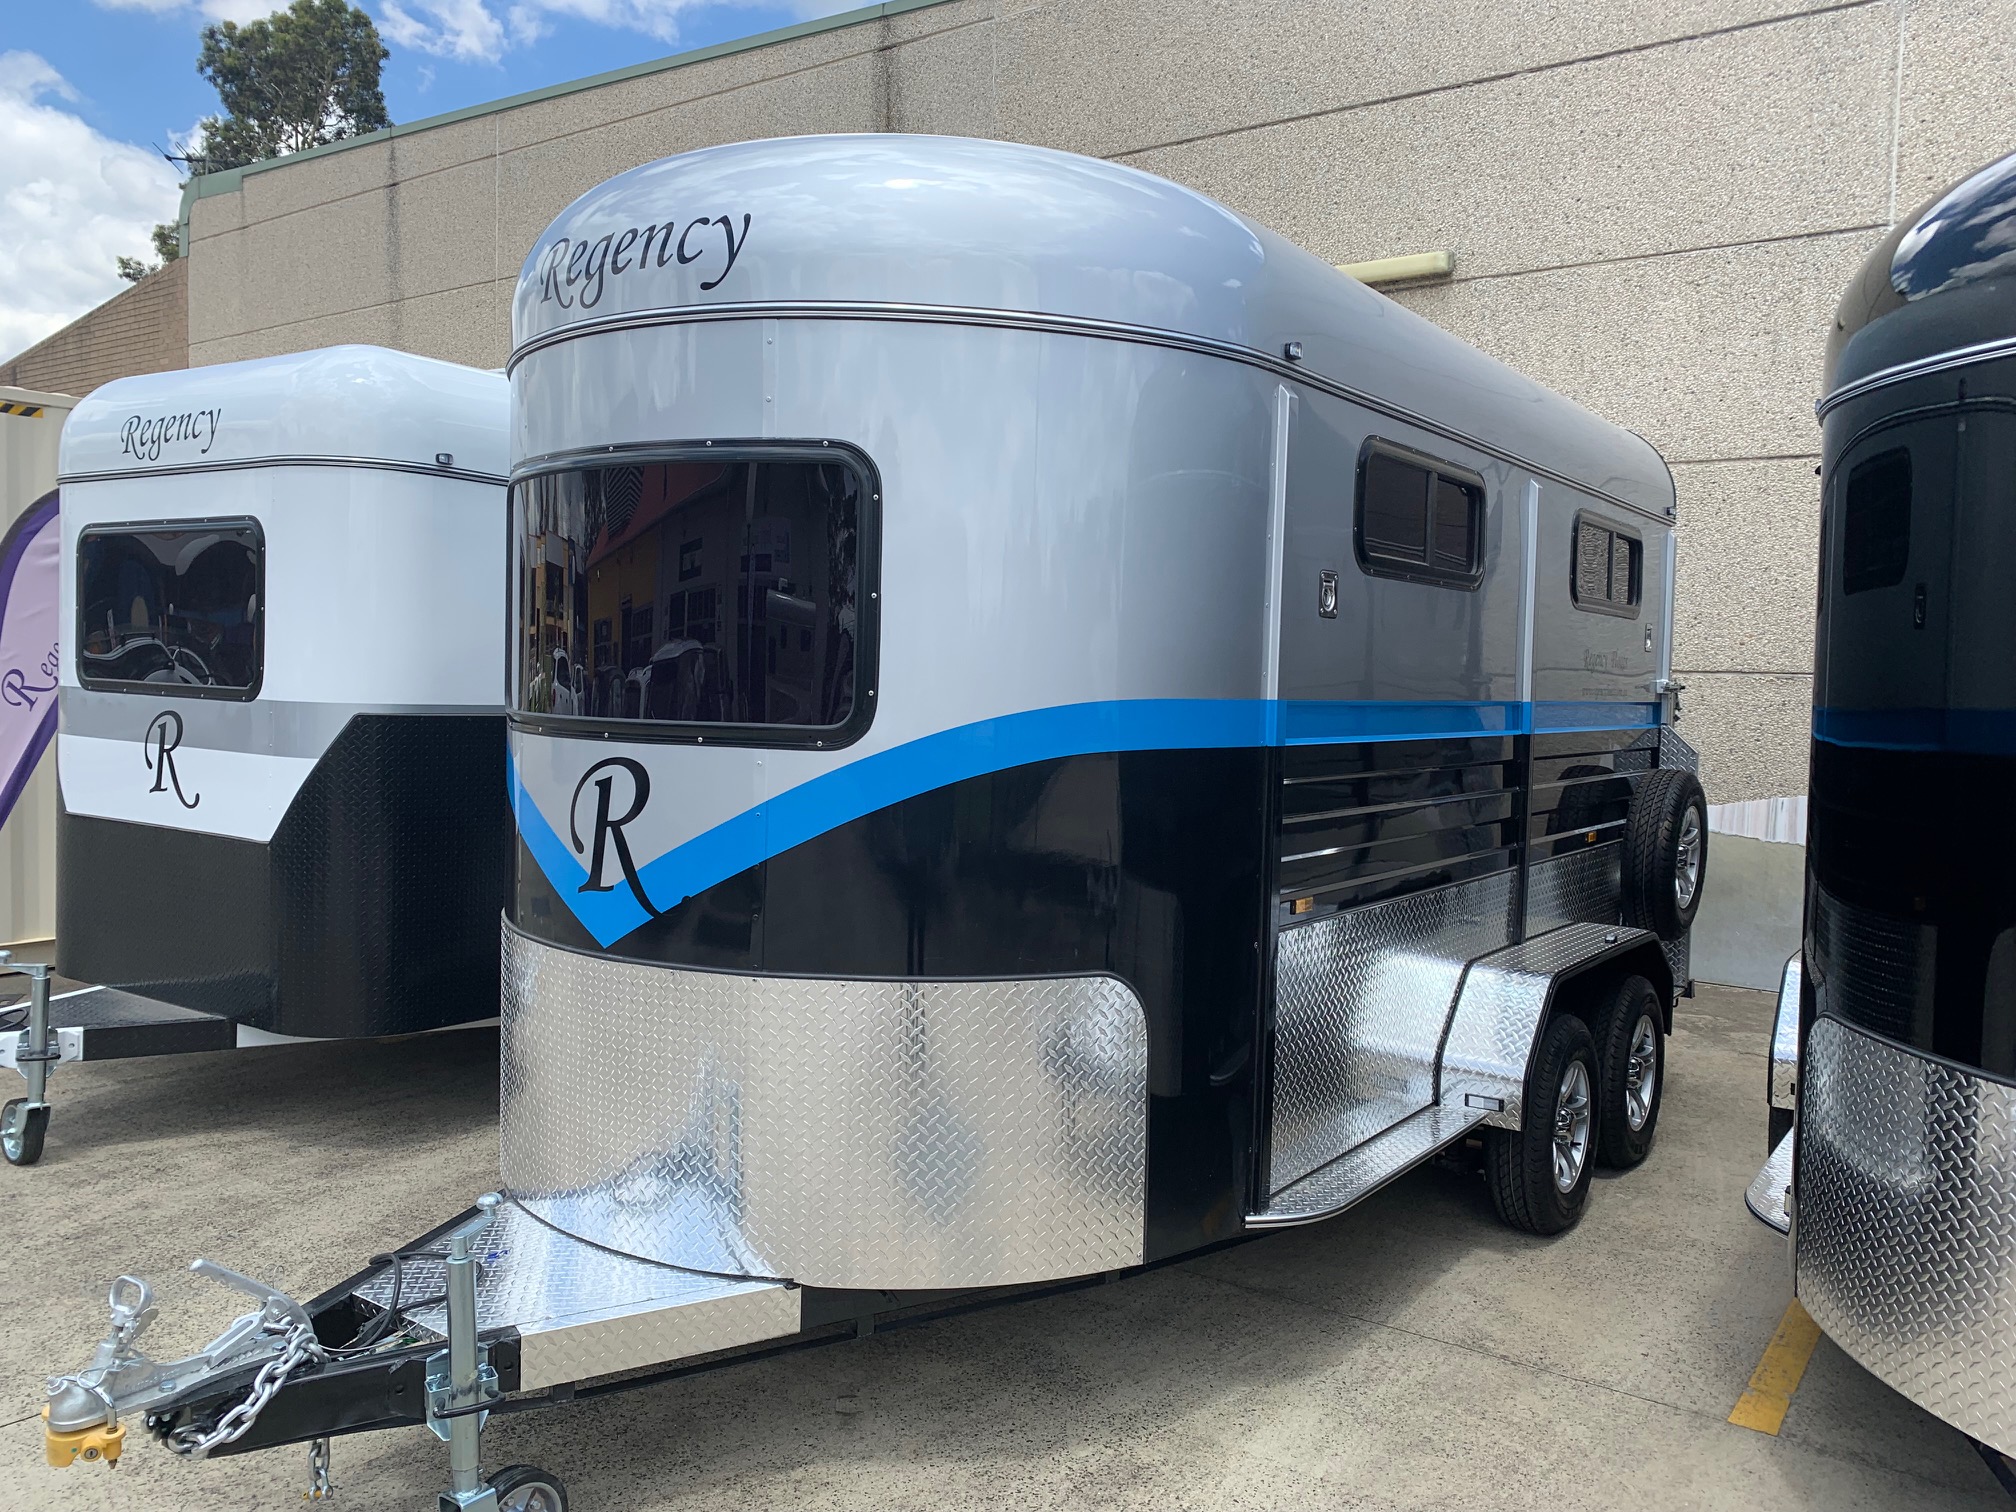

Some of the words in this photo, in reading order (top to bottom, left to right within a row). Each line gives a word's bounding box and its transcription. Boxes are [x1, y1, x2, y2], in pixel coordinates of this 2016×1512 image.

[540, 212, 752, 310] Regency
[120, 408, 222, 462] Regency
[144, 709, 200, 809] R
[569, 756, 692, 923] R
